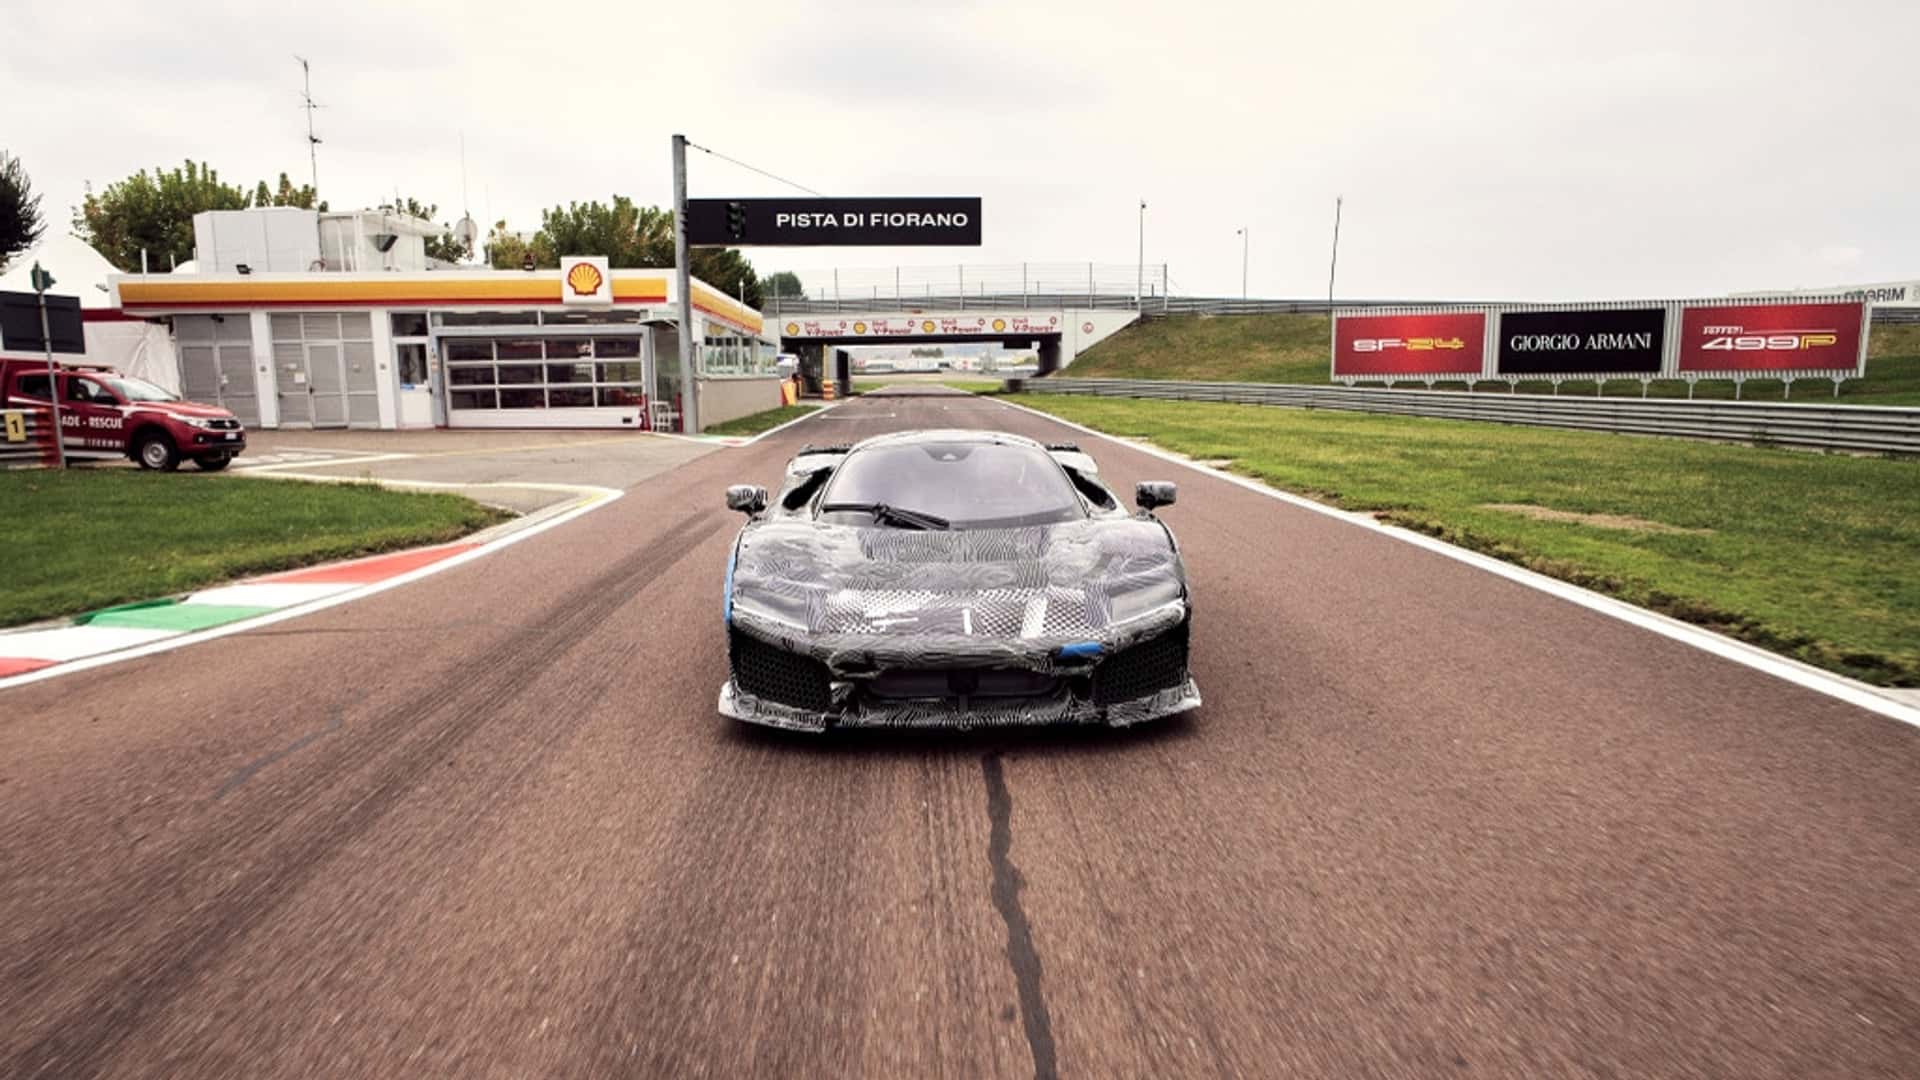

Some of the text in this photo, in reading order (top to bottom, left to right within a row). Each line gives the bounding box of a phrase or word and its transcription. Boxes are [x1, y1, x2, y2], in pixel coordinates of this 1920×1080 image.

[776, 213, 969, 228] PISTA DI FIORANO
[1353, 338, 1464, 351] SF-24
[1510, 333, 1652, 351] GIORGIO ARMANI
[1701, 335, 1837, 350] 499P
[11, 419, 19, 434] 1
[88, 416, 123, 429] RESCUE
